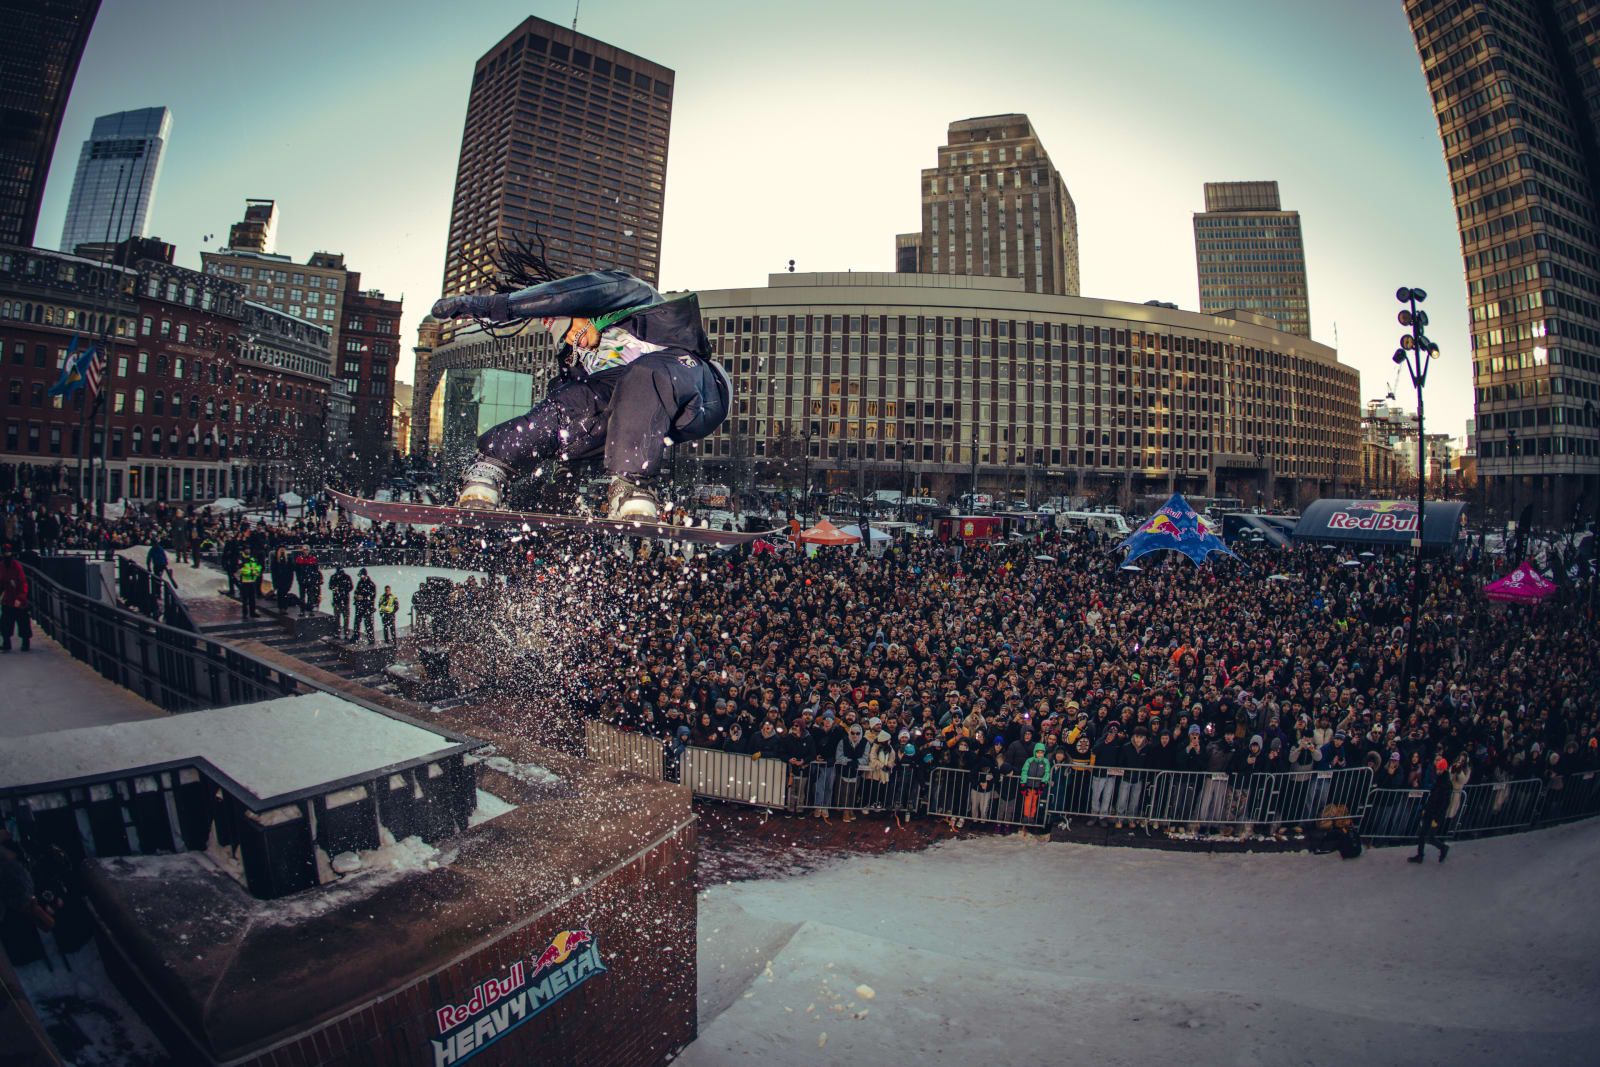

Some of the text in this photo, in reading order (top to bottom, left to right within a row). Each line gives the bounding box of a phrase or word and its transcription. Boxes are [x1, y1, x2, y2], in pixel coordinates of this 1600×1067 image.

[1328, 511, 1376, 528] Red
[431, 938, 607, 1067] HEAVY METAL
[436, 960, 525, 1034] Red Bull
